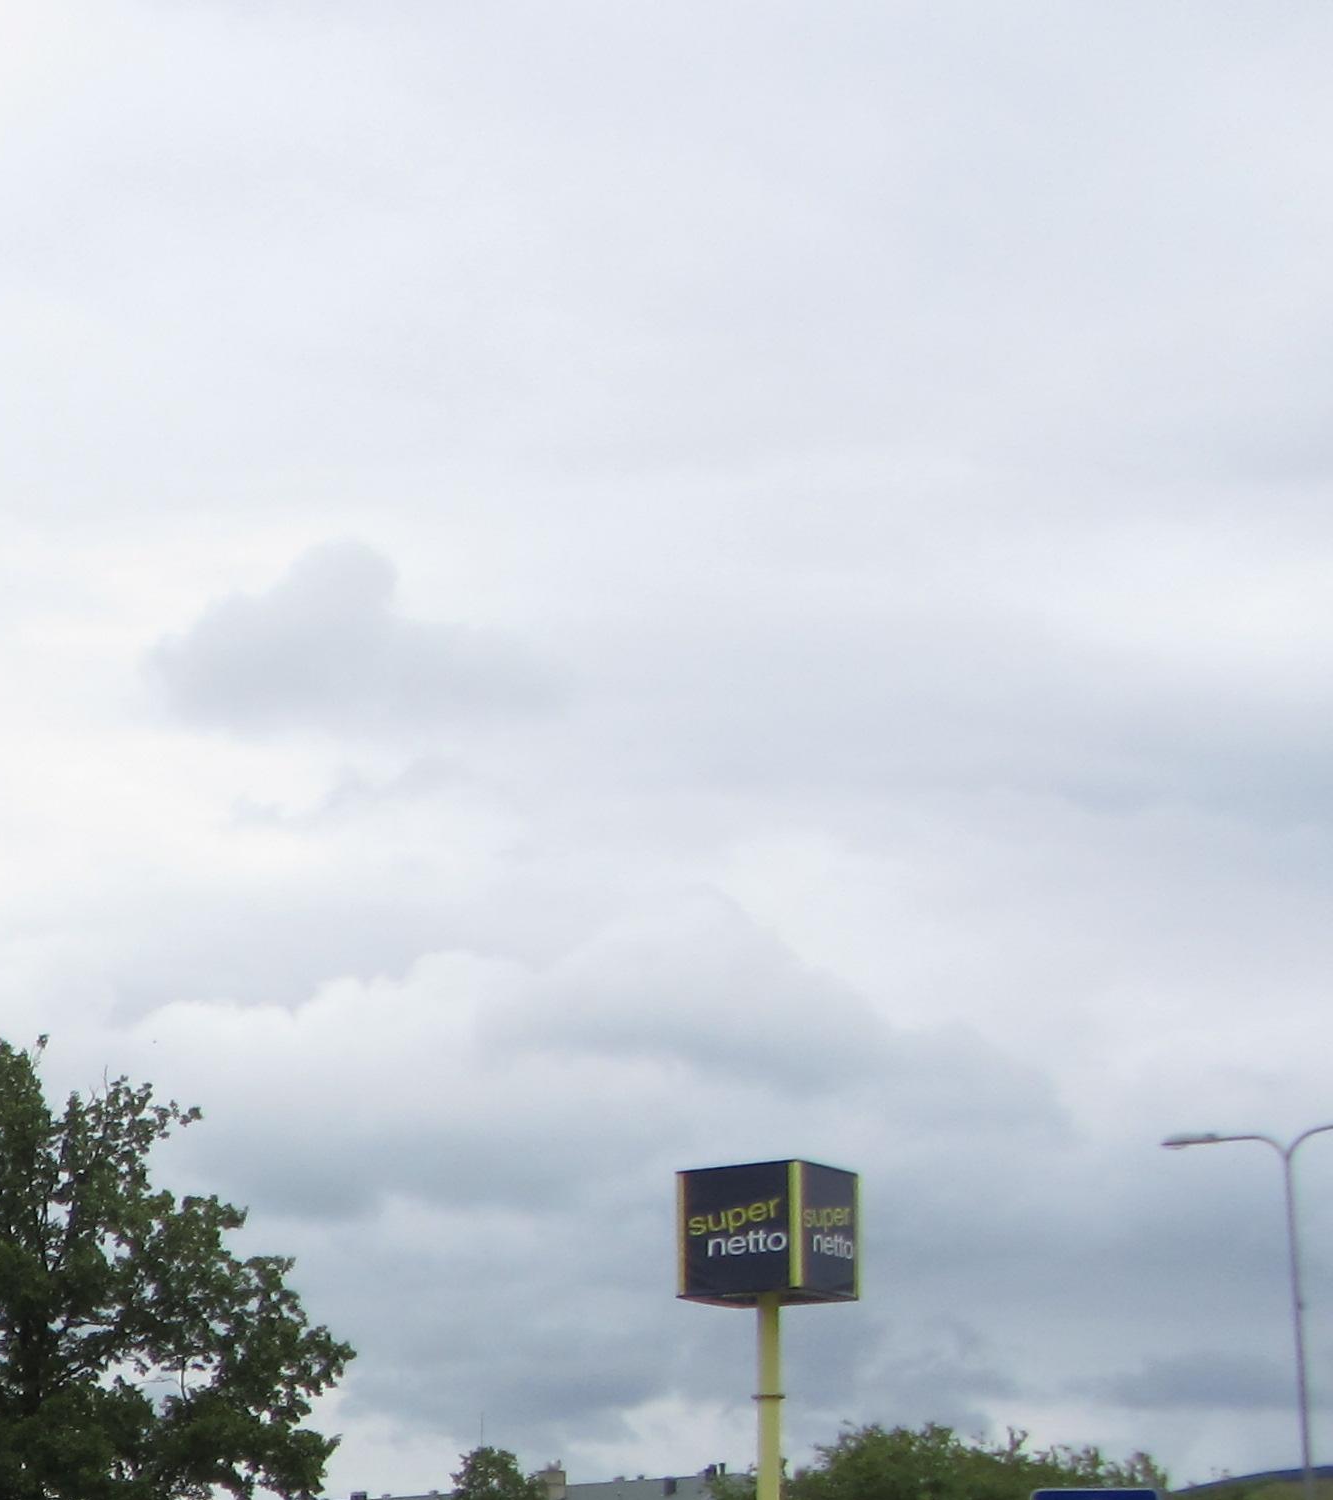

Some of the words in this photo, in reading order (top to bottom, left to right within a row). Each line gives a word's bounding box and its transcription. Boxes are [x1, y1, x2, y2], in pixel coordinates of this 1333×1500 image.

[688, 1198, 781, 1235] super
[803, 1207, 851, 1232] super
[707, 1230, 787, 1257] netto
[813, 1234, 853, 1259] netto
